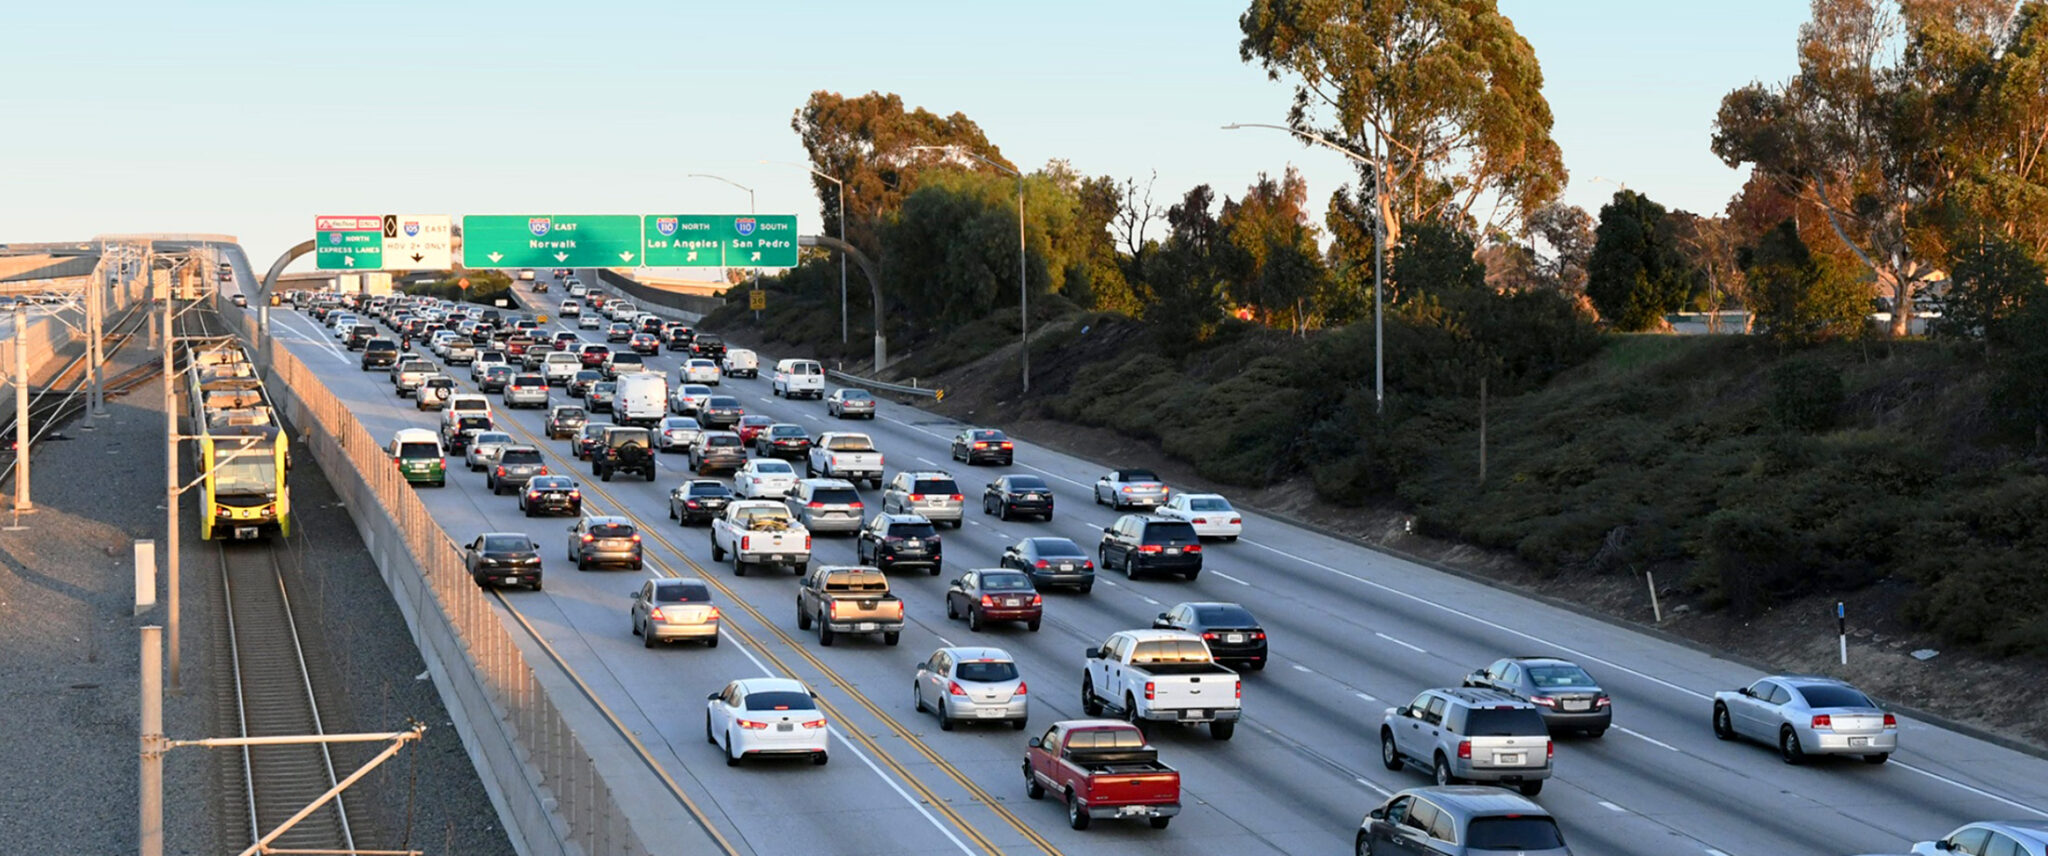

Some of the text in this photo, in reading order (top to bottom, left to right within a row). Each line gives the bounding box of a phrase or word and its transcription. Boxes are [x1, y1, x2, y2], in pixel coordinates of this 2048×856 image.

[532, 223, 547, 232] 105
[661, 222, 674, 231] 110
[740, 223, 752, 231] 110
[530, 240, 576, 248] Norwalk
[648, 239, 718, 250] Los Angeles
[732, 238, 790, 248] San Pedro
